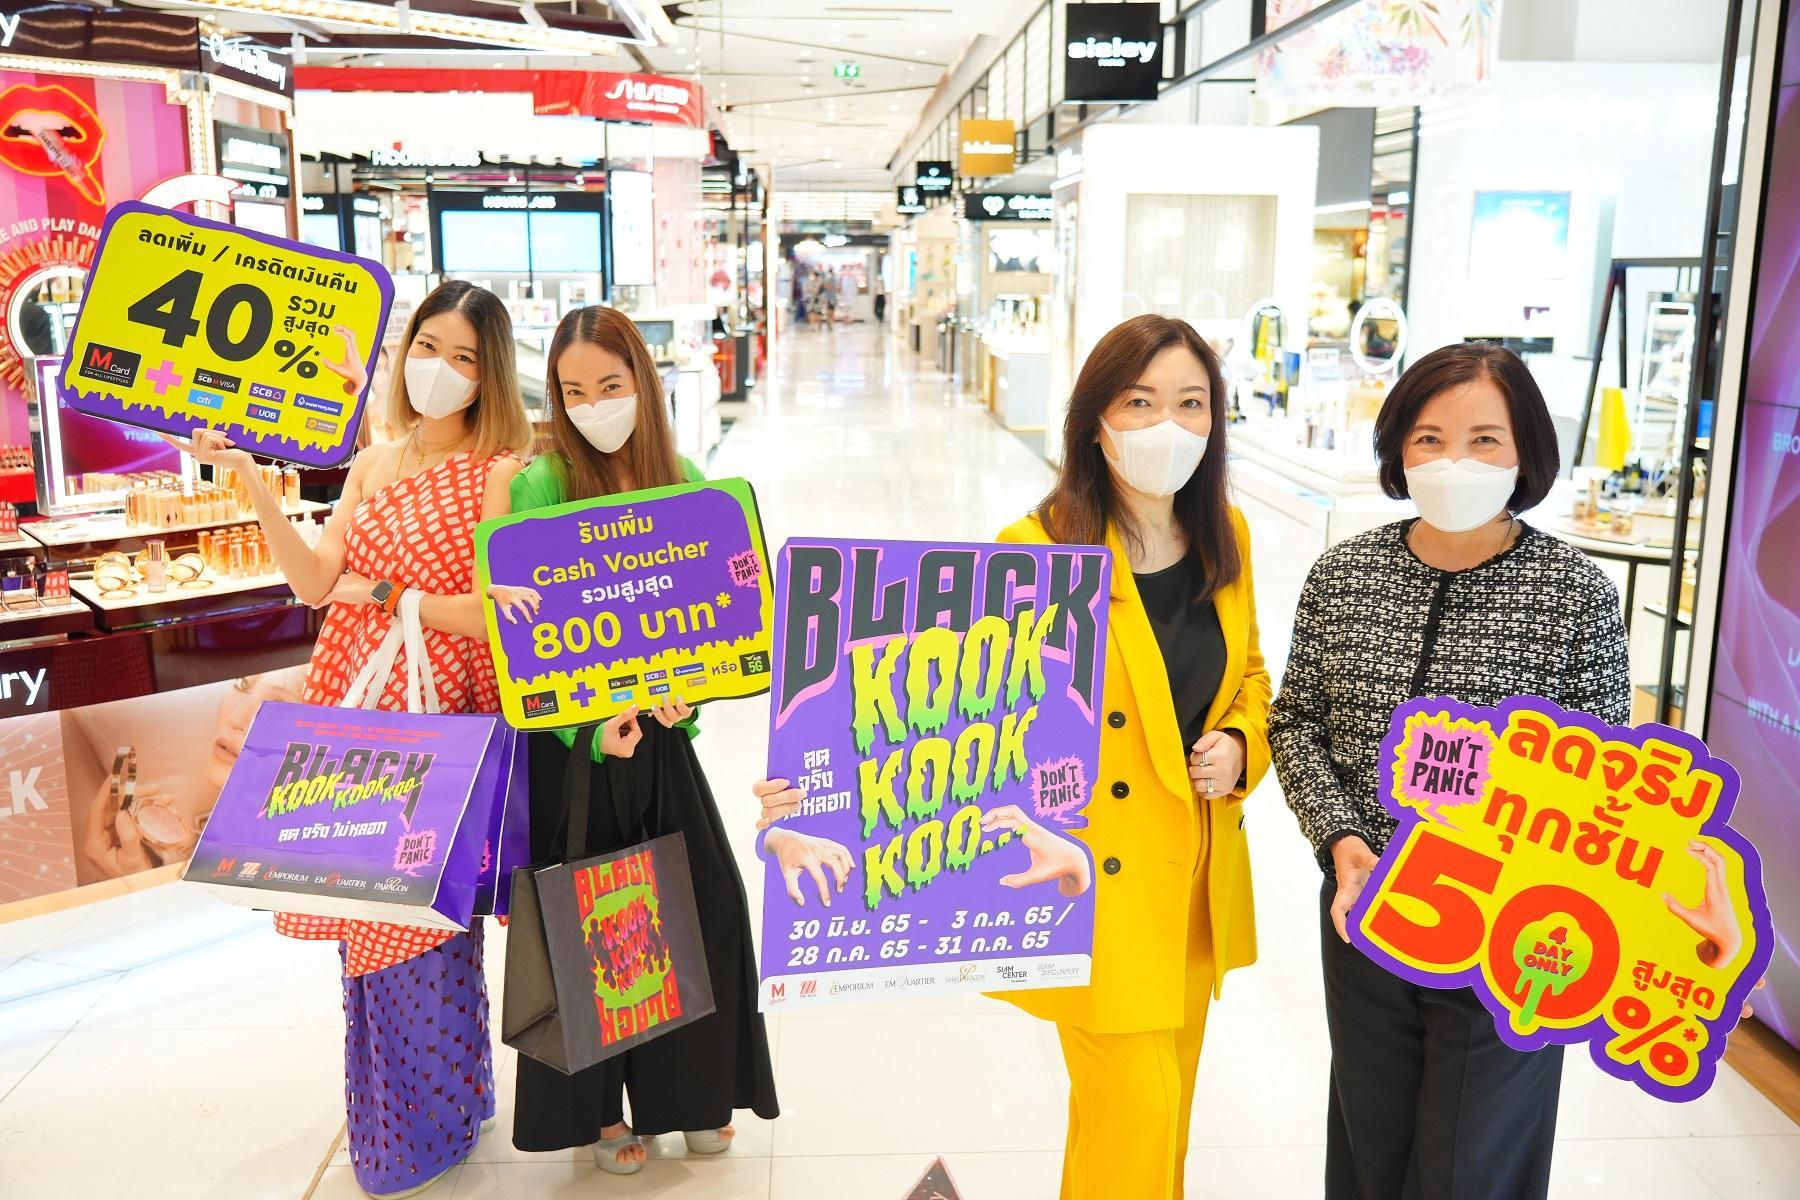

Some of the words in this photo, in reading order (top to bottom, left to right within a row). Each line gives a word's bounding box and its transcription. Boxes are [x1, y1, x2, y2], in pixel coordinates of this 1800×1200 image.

[11, 218, 39, 237] AND
[41, 217, 75, 231] PLAY
[138, 228, 206, 257] ลดเพิ่ม
[234, 253, 358, 295] เครดิตเงินคืน
[128, 269, 273, 362] 40
[288, 295, 337, 320] รวม
[283, 315, 330, 339] สูงสุด
[89, 348, 113, 371] M
[110, 364, 131, 376] Card
[197, 375, 213, 384] SCB
[220, 380, 236, 389] VISA
[252, 386, 273, 398] SCB
[197, 395, 212, 405] citi
[258, 408, 277, 420] UOB
[578, 508, 654, 544] รับเพิ่ม
[533, 558, 596, 587] Cash
[603, 539, 709, 573] Voucher
[732, 554, 755, 571] DON'T
[581, 573, 673, 604] รวมสูงสุด
[532, 611, 622, 660] 800
[775, 545, 1107, 730] BLACK
[645, 673, 660, 681] SCB
[711, 661, 737, 676] หรือ
[748, 660, 764, 673] 5G
[850, 602, 1059, 756] KOOK
[526, 696, 541, 711] M
[541, 701, 554, 709] Card
[1748, 696, 1778, 728] WITH
[1780, 713, 1791, 735] A
[1419, 732, 1484, 769] DON'T
[857, 704, 1039, 838] KOOK
[1039, 761, 1078, 789] DON'T
[1508, 717, 1712, 819] ลดจริง
[257, 742, 437, 832] BLACK
[267, 771, 345, 820] KOOK
[332, 775, 389, 811] KOOK
[403, 833, 432, 851] DON'T
[1482, 786, 1665, 889] ทุกชั้น
[573, 849, 659, 924] BLACK
[789, 920, 821, 940] 30
[827, 916, 871, 938] มิ.ย.
[881, 913, 911, 934] 65
[951, 910, 968, 929] 3
[972, 911, 1016, 929] ก.ค.
[1024, 906, 1054, 926] 65
[1368, 829, 1620, 1020] 50
[1548, 926, 1568, 945] 4
[787, 946, 819, 967] 28
[825, 946, 871, 964] ก.ค.
[880, 939, 910, 959] 65
[934, 936, 962, 955] 31
[970, 935, 1013, 953] ก.ค.
[1021, 930, 1051, 950] 65
[1533, 940, 1574, 962] DAY
[997, 965, 1014, 973] SIAM
[1523, 954, 1574, 977] ONLY
[771, 982, 786, 998] M
[1632, 959, 1716, 1012] สูงสุด
[595, 963, 683, 1048] BLACK
